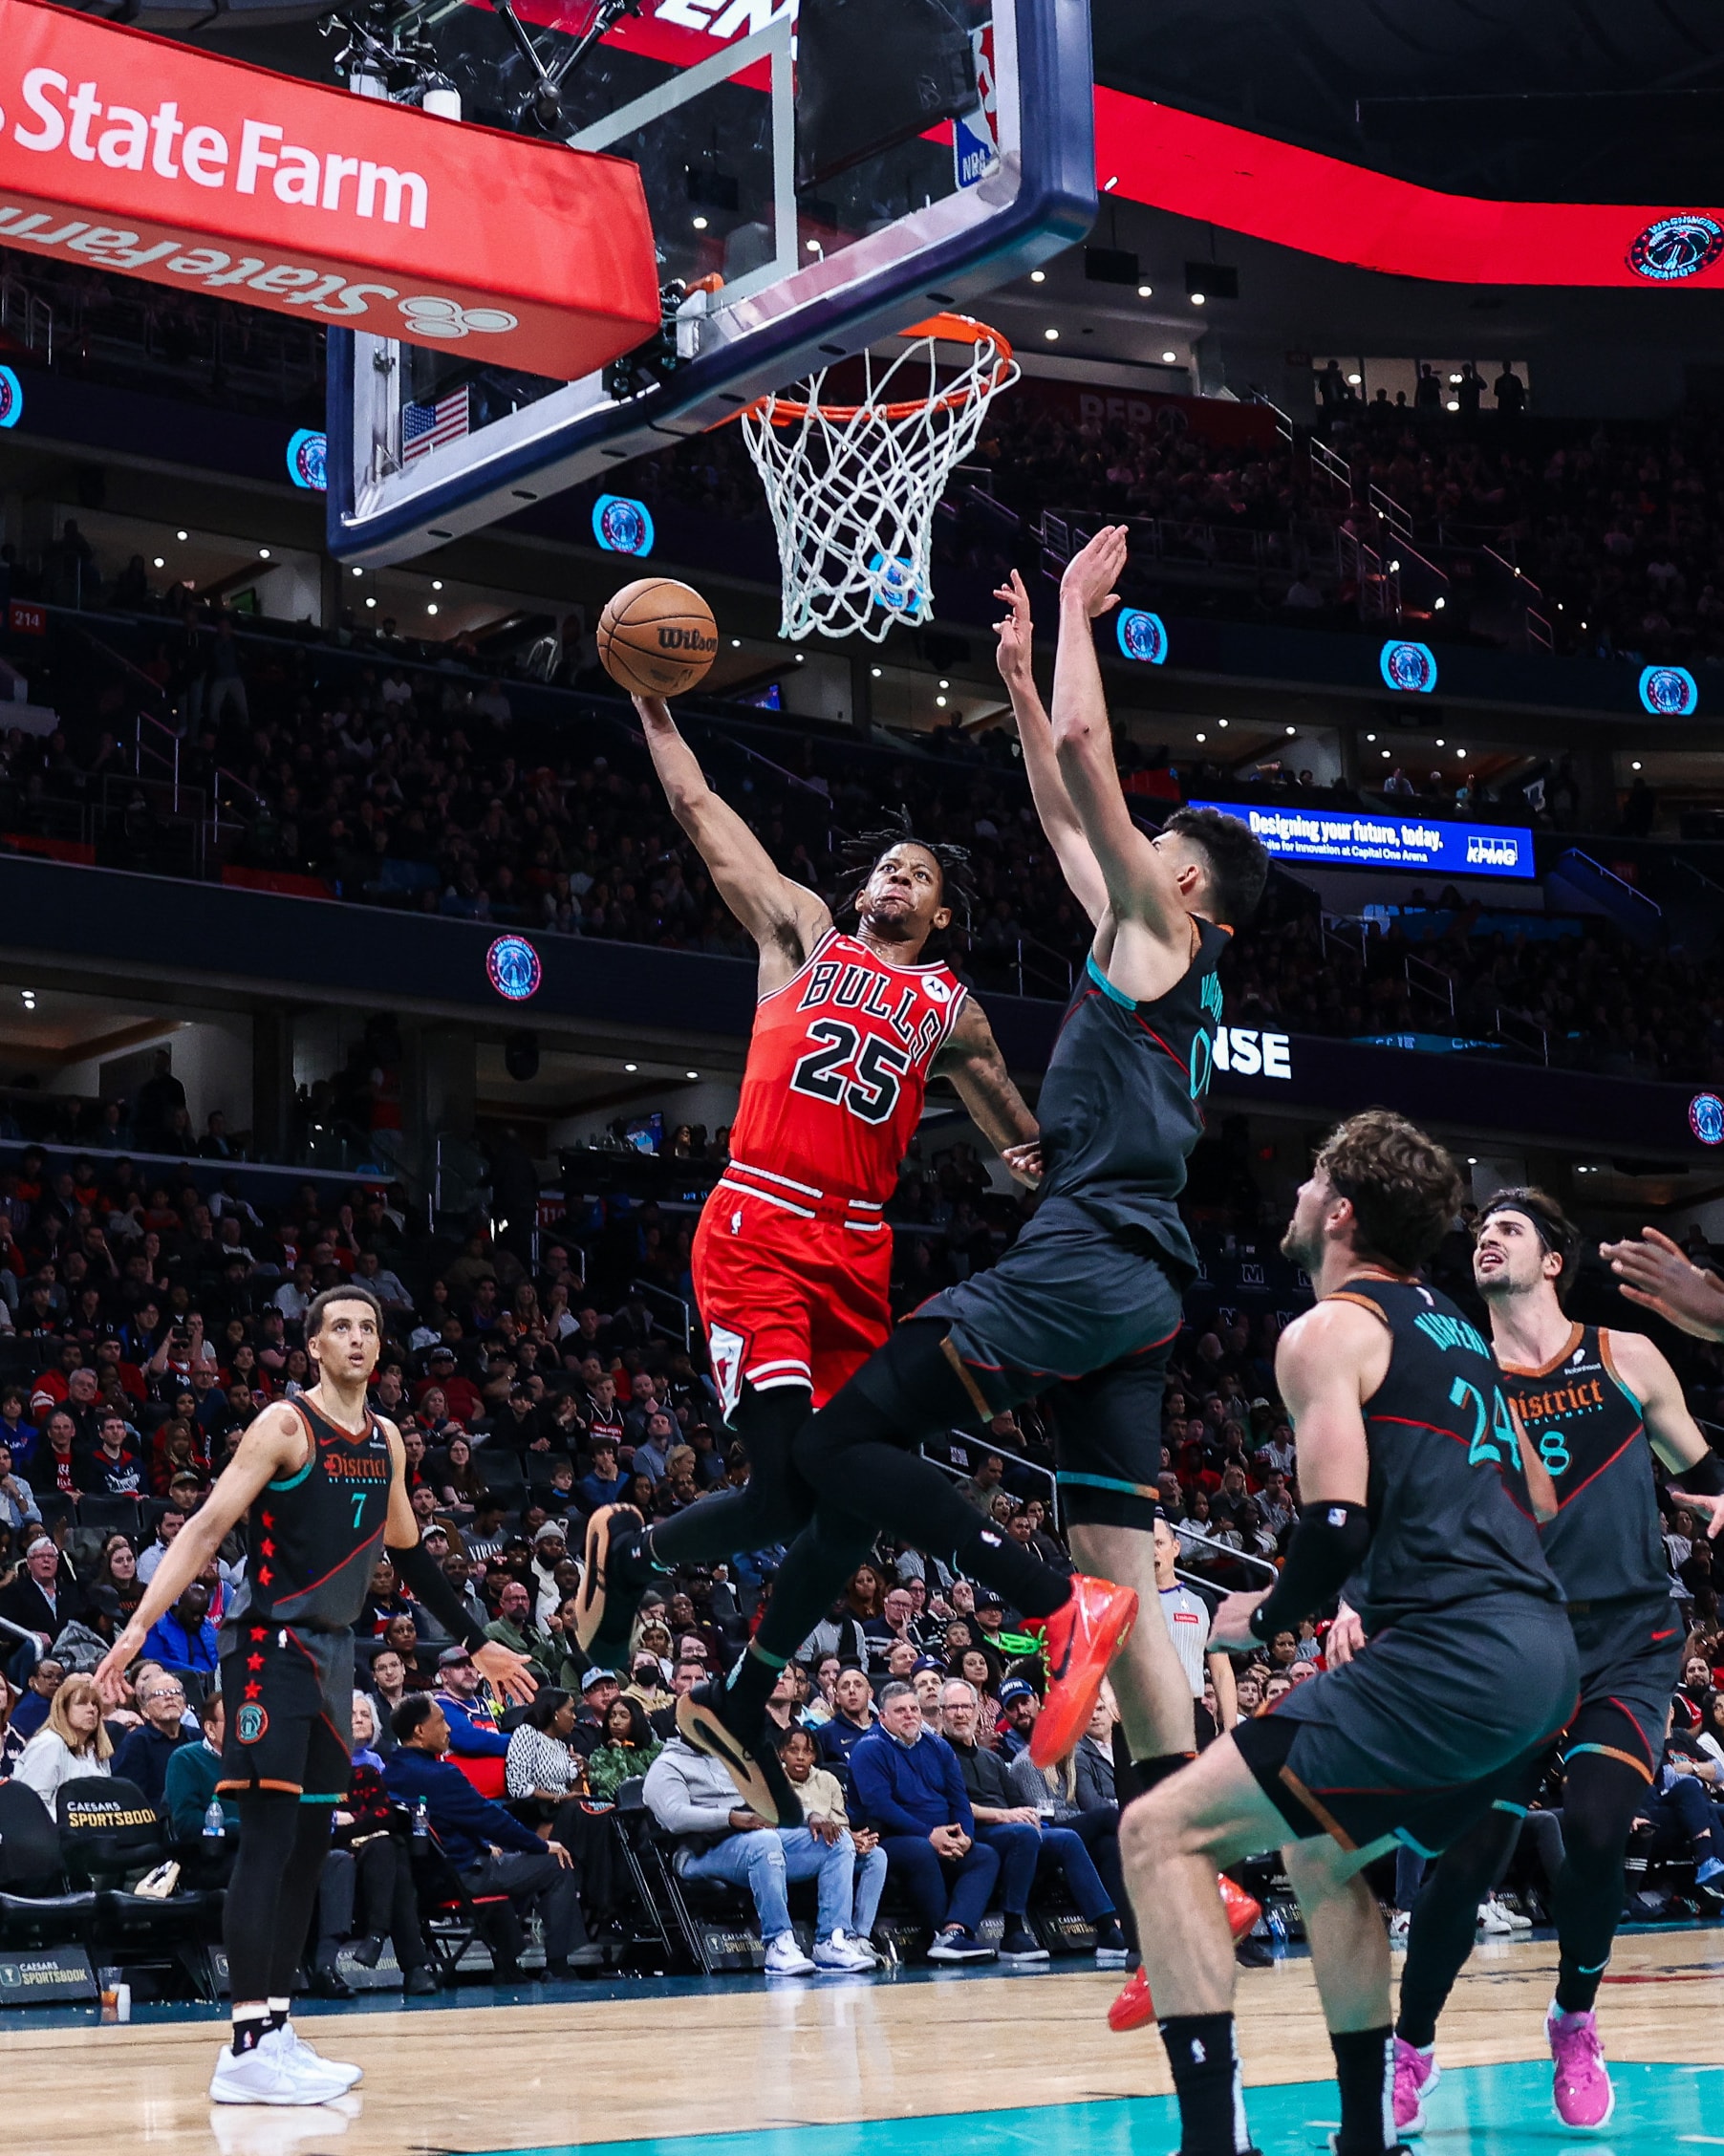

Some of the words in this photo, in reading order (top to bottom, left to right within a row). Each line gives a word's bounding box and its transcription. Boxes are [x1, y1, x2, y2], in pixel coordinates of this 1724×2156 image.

[14, 610, 40, 627] 214
[657, 626, 718, 653] Wilson
[1249, 810, 1321, 843] Designing
[1321, 821, 1352, 843] your
[1352, 820, 1401, 848] future,
[1401, 825, 1444, 852] today.
[1281, 840, 1295, 852] for
[1295, 841, 1341, 855] innovation
[1341, 846, 1351, 856] at
[1351, 846, 1383, 860] Capital
[1382, 848, 1402, 860] One
[1402, 850, 1429, 862] Arena
[1466, 845, 1518, 867] KPMG
[796, 961, 941, 1067] BULLS
[789, 1017, 912, 1125] 25
[1449, 1376, 1522, 1473] 24
[324, 1452, 387, 1477] District
[1540, 1430, 1572, 1476] 8
[350, 1492, 368, 1529] 7
[66, 1800, 121, 1812] CAESARS
[19, 1961, 59, 1972] CAESARS
[22, 1967, 88, 1986] SPORTSBOOK
